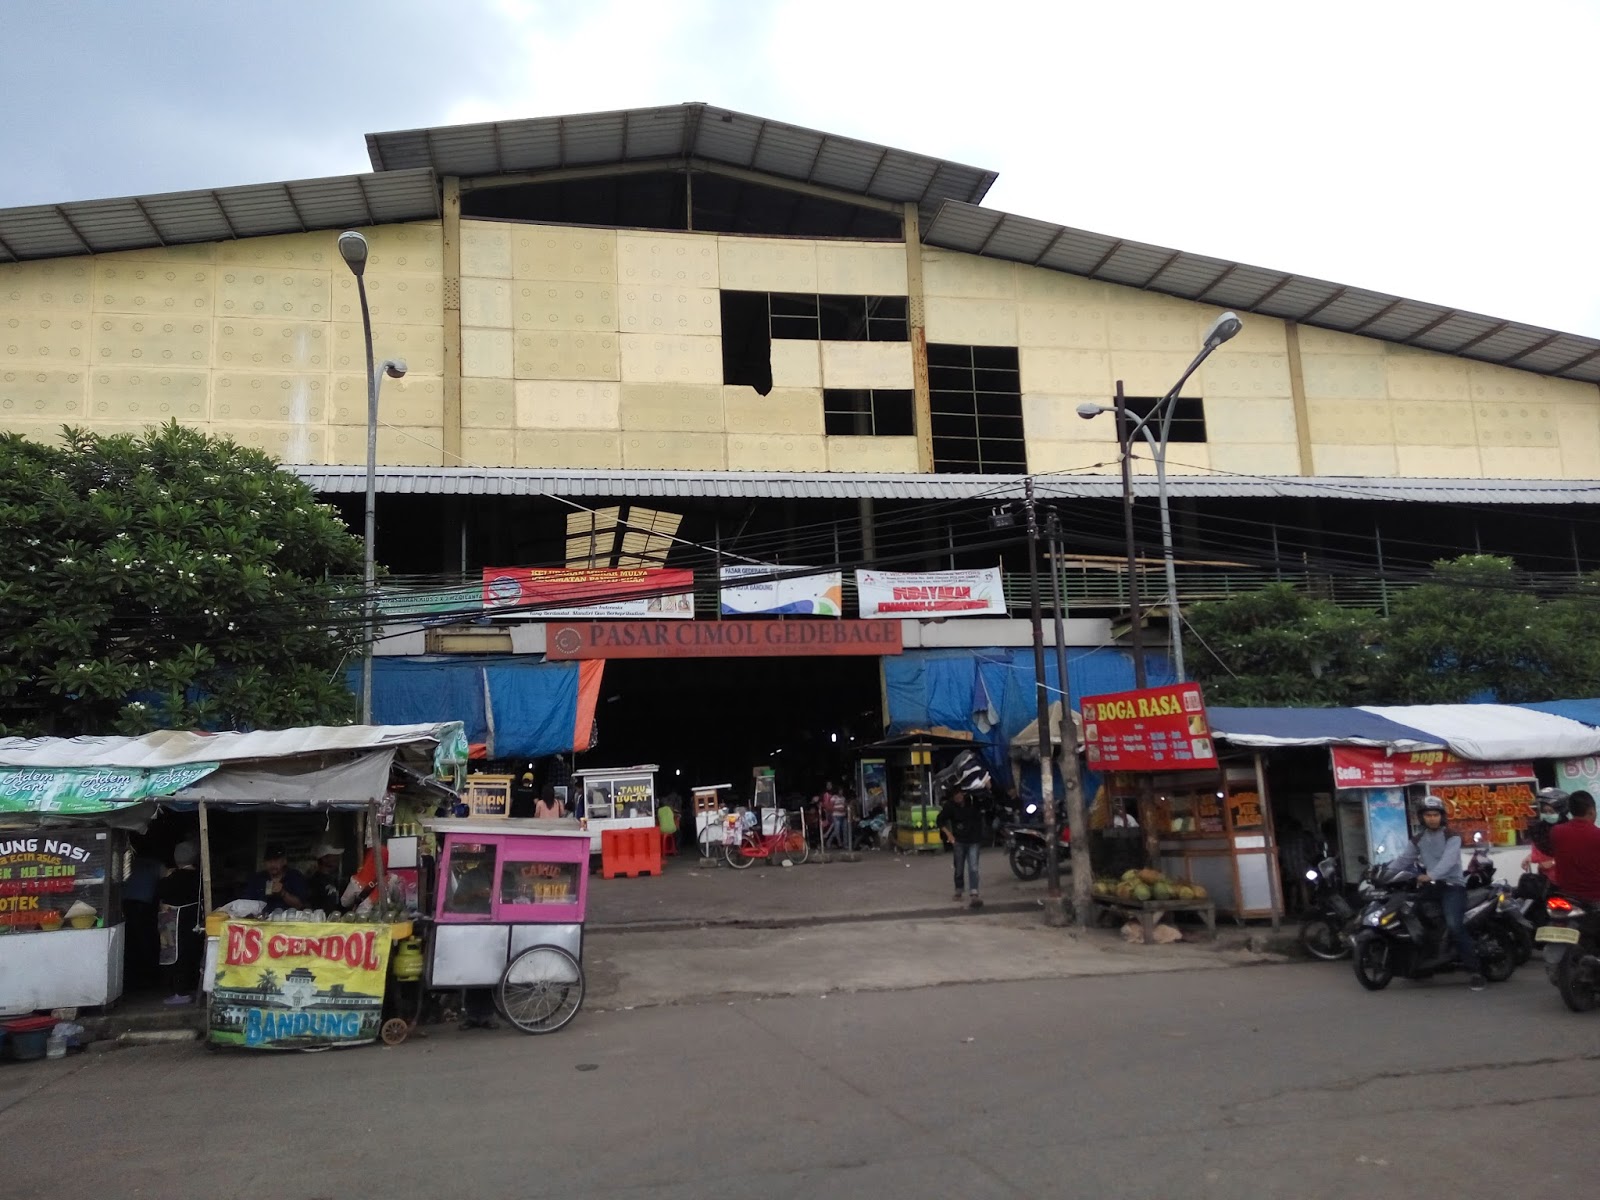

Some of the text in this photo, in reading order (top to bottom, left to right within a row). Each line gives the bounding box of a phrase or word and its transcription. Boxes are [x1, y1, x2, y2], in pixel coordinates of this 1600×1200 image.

[589, 624, 668, 647] PASAR
[683, 622, 759, 645] CIMOL
[765, 620, 897, 644] GEDEBAGE
[1097, 694, 1182, 721] BOGA RASA
[2, 769, 54, 785] Adem
[81, 771, 131, 787] Adem
[5, 781, 45, 796] Sari
[84, 783, 123, 798] Sari
[620, 785, 646, 794] TAHU
[1455, 784, 1535, 801] KELAPA
[616, 795, 649, 803] BULAT
[1459, 802, 1537, 819] MUDA
[0, 839, 91, 863] UNG NASI
[225, 924, 383, 971] ES CENDOL
[246, 1006, 362, 1047] BANDUNG
